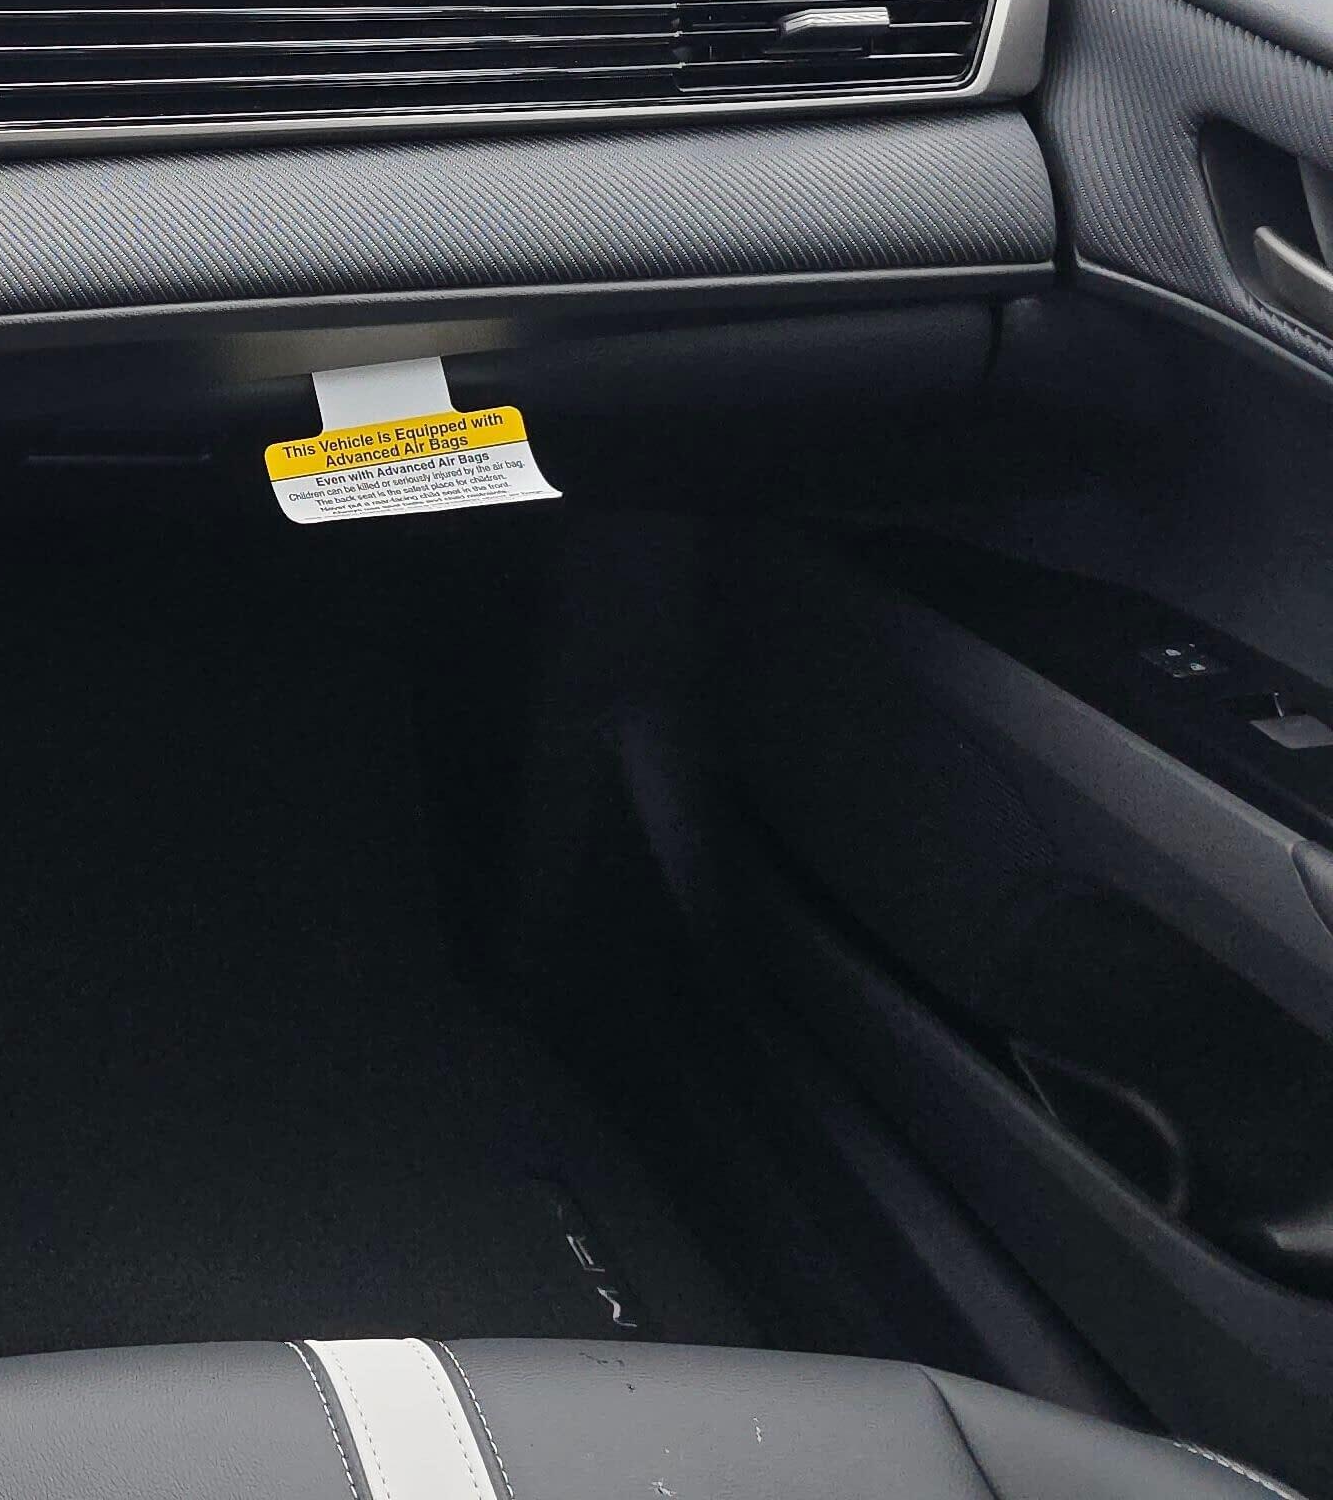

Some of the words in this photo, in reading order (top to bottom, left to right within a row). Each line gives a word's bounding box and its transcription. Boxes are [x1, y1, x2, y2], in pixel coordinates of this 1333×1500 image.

[282, 443, 316, 459] This
[319, 434, 373, 452] Vehicle
[377, 431, 391, 443] is
[395, 417, 467, 441] Equipped
[471, 413, 503, 429] with
[326, 445, 400, 468] Advanced
[404, 441, 424, 456] Air
[428, 435, 468, 451] Bags
[288, 490, 325, 502] Children
[327, 488, 343, 496] can
[344, 484, 356, 493] be
[381, 479, 391, 487] or
[393, 473, 431, 486] seriously
[433, 467, 462, 481] injured
[464, 466, 475, 476] by
[476, 464, 491, 474] the
[493, 461, 503, 471] air
[316, 475, 349, 487] Even
[349, 470, 374, 480] with
[377, 457, 435, 478] Advanced
[438, 455, 455, 468] Air
[458, 451, 490, 465] Bags
[315, 498, 333, 507] The
[334, 494, 355, 504] back
